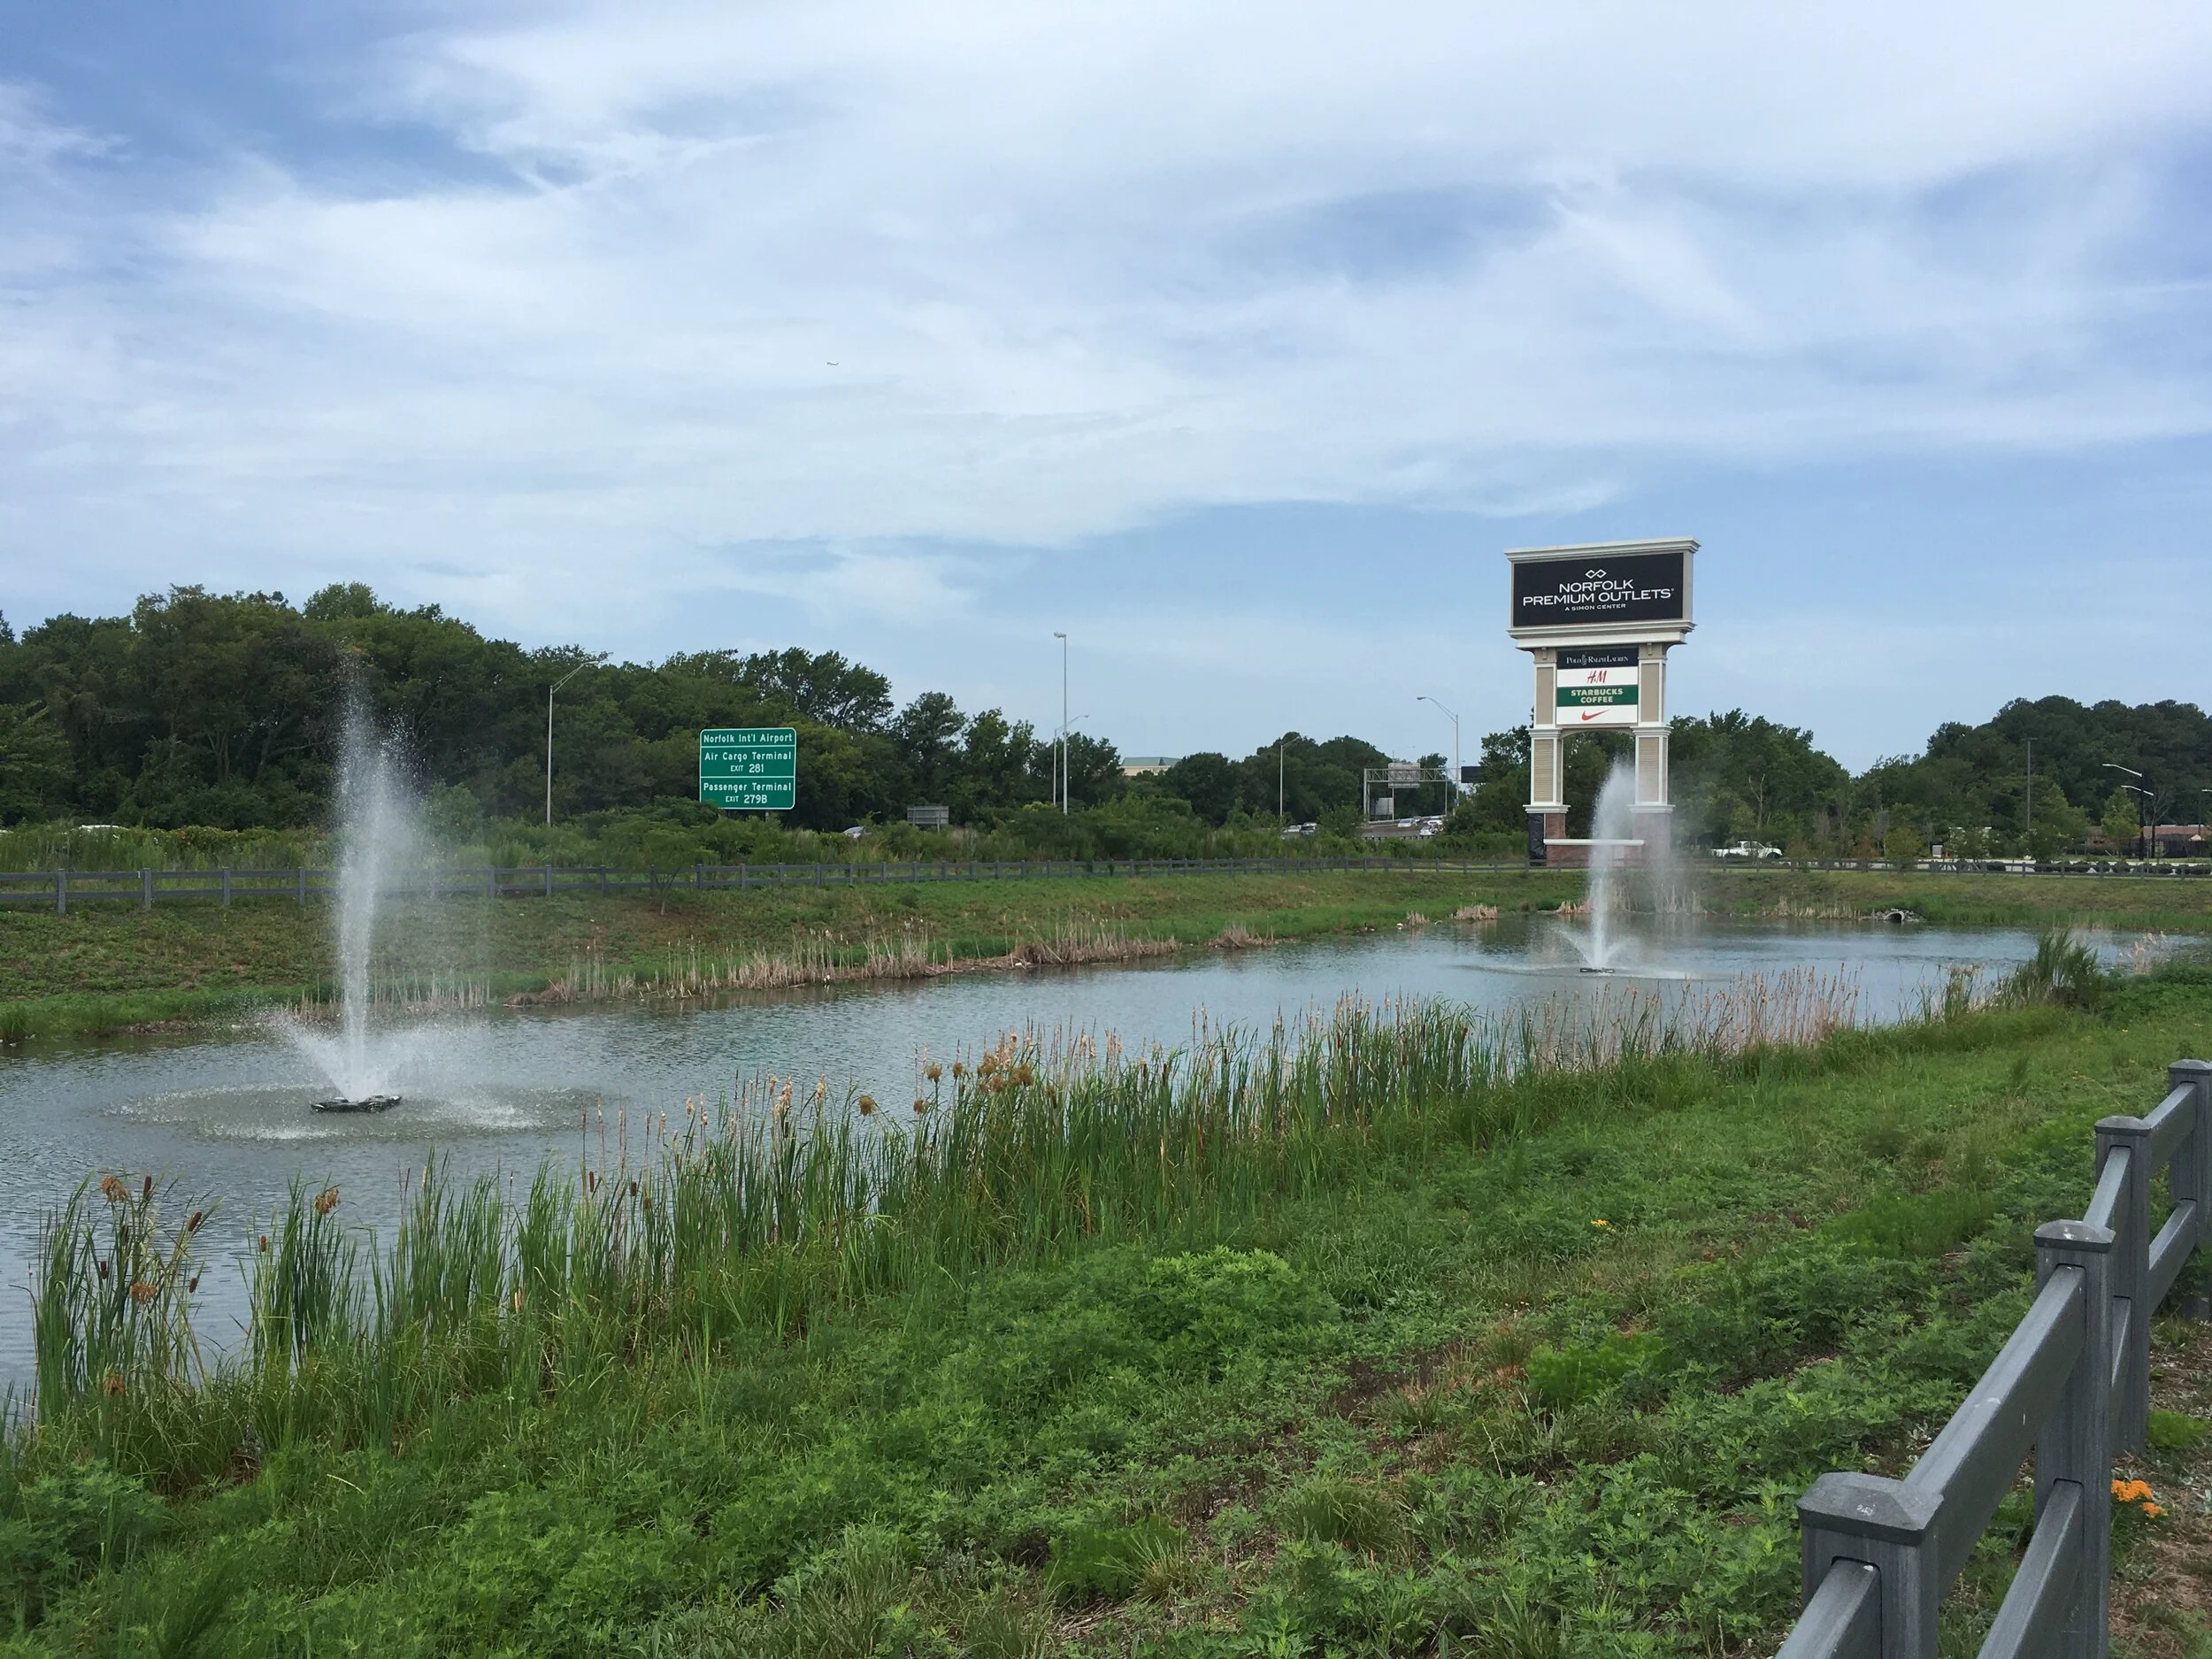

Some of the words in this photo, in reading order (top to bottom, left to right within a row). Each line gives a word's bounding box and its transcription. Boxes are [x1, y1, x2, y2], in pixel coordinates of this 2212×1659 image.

[1559, 579, 1634, 594] NORFOLK
[1523, 593, 1594, 606] PREMIUM
[1586, 670, 1608, 684] H&M
[703, 734, 735, 743] Norfolk
[739, 733, 756, 742] Int'l
[760, 733, 792, 743] Airport
[722, 752, 748, 762] Cargo
[752, 751, 791, 760] Terminal
[749, 764, 764, 773] 281
[703, 782, 748, 793] Passenger
[752, 782, 791, 791] Terminal
[743, 794, 768, 804] 279B
